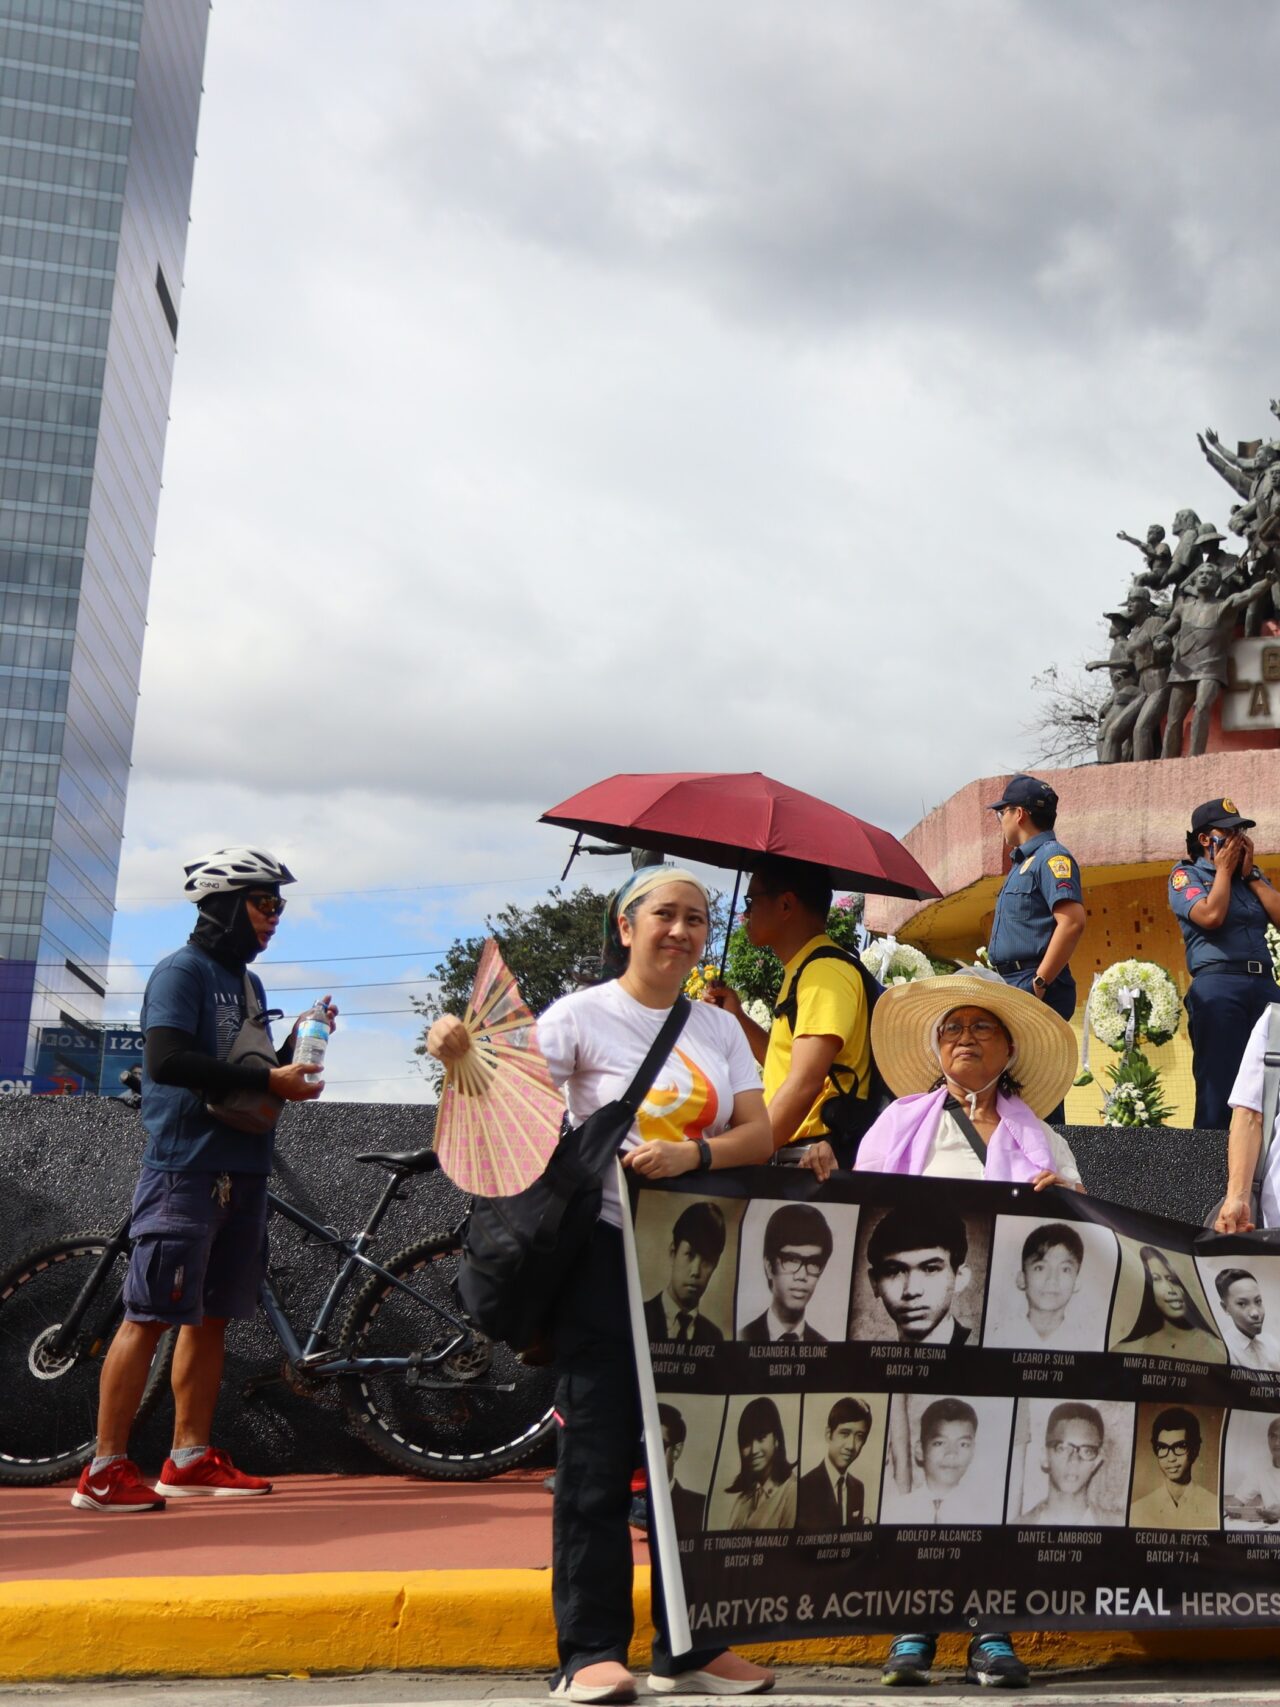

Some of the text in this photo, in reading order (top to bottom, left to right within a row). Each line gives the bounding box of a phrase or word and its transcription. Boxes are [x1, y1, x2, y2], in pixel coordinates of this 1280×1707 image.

[110, 1036, 144, 1051] IZO
[650, 1343, 675, 1355] RIANO
[689, 1345, 716, 1358] LOPEZ
[749, 1346, 828, 1358] ALEXANDER A. BELONE
[870, 1346, 947, 1360] PASTOR R. MESINA
[1012, 1352, 1075, 1365] LAZARO P. SILVA
[653, 1361, 679, 1374] BATCH
[769, 1364, 792, 1377] BATCH
[886, 1364, 913, 1376] BATCH
[1123, 1357, 1148, 1369] NIMFA
[1158, 1360, 1173, 1371] DEL
[1174, 1362, 1209, 1375] ROSARIO
[1022, 1369, 1048, 1381] BATCH
[1142, 1374, 1166, 1386] BATCH
[1250, 1386, 1274, 1398] BATCH
[797, 1534, 832, 1546] FLORENCIO
[839, 1531, 873, 1543] MONTALBO
[896, 1529, 983, 1542] ADOLFO P. ALCANCES
[1018, 1531, 1102, 1545] DANTE L. AMBROSIO
[1135, 1532, 1210, 1547] CECILIO A. REYES,
[1226, 1534, 1255, 1545] CARLITO
[704, 1535, 789, 1551] FE TIONGSON-MANALO
[817, 1549, 838, 1560] BATCH
[917, 1548, 945, 1560] BATCH
[1037, 1550, 1066, 1562] BATCH
[1147, 1550, 1174, 1562] BATCH
[1247, 1549, 1269, 1560] BATCH
[724, 1555, 750, 1568] BATCH
[796, 1594, 814, 1621] &
[822, 1589, 955, 1618] ACTIVISTS
[962, 1589, 1017, 1615] ARE
[1025, 1590, 1087, 1615] OUR
[1095, 1587, 1171, 1617] REAL
